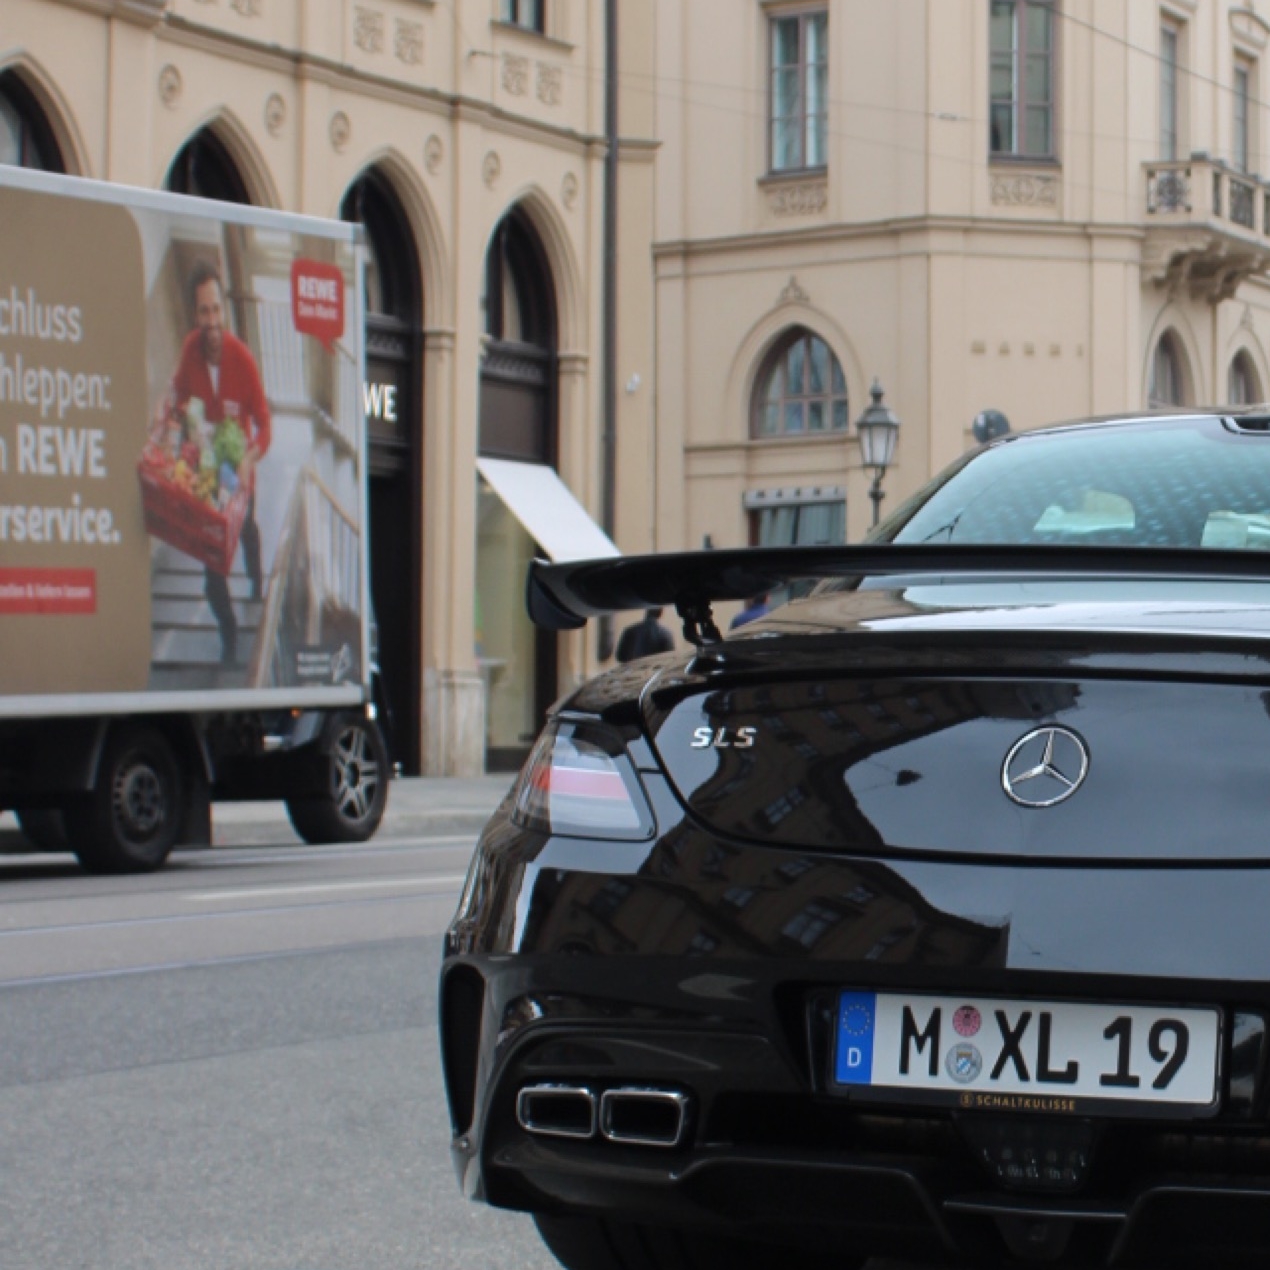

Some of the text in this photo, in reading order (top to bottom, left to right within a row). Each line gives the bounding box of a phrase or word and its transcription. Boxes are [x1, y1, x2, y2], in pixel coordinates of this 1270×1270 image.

[297, 275, 337, 301] REWE
[17, 422, 107, 478] REWE
[690, 726, 757, 747] SLS
[847, 1048, 861, 1068] D
[900, 1005, 1189, 1089] M XL 19
[976, 1094, 1076, 1111] SCHALTKULISSE
